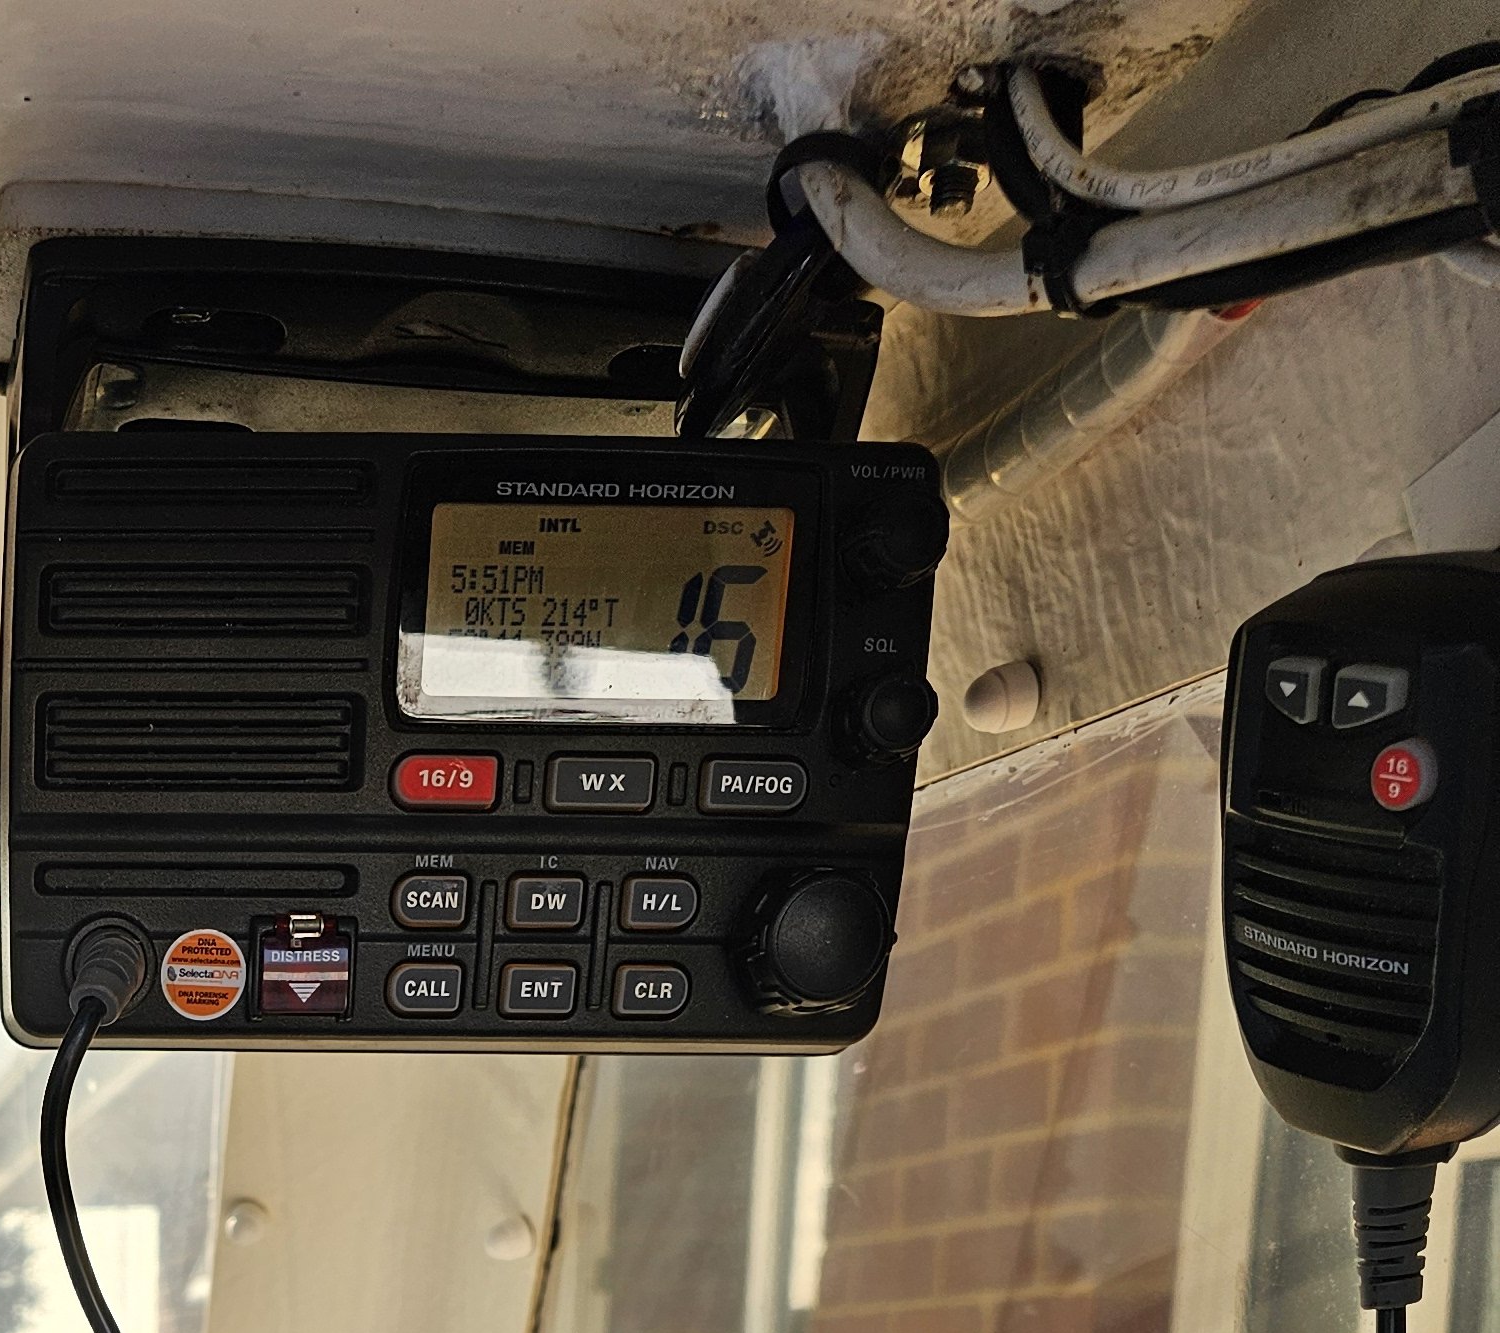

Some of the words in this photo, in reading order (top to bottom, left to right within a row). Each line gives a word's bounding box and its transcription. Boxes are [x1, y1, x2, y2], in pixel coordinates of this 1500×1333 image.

[850, 464, 926, 479] VOL/PWR
[496, 481, 619, 498] STANDARD
[629, 483, 735, 499] HORIZON
[539, 518, 580, 533] INTL
[704, 521, 743, 535] DSC
[500, 541, 534, 555] MEM
[451, 564, 544, 594] 5:51PM
[669, 564, 768, 693] 16
[864, 638, 897, 653] SQL
[1386, 757, 1408, 775] 16
[418, 768, 474, 789] 16/9
[720, 774, 793, 795] PA/FOG
[1389, 783, 1399, 798] 9
[415, 855, 453, 869] MEM
[646, 857, 678, 871] NAV
[406, 892, 459, 909] SCAN
[531, 894, 566, 910] DW
[642, 894, 682, 911] H/L
[198, 938, 217, 947] DNA
[182, 946, 231, 956] PROTECTED
[271, 951, 340, 962] DISTRESS
[408, 944, 455, 958] MENU
[1243, 926, 1318, 959] STANDARD
[1323, 950, 1409, 975] HORIZON
[178, 991, 193, 999] DNA
[195, 991, 228, 999] FORENSIC
[404, 981, 451, 998] CALL
[520, 981, 562, 998] ENT
[634, 982, 672, 999] CLR
